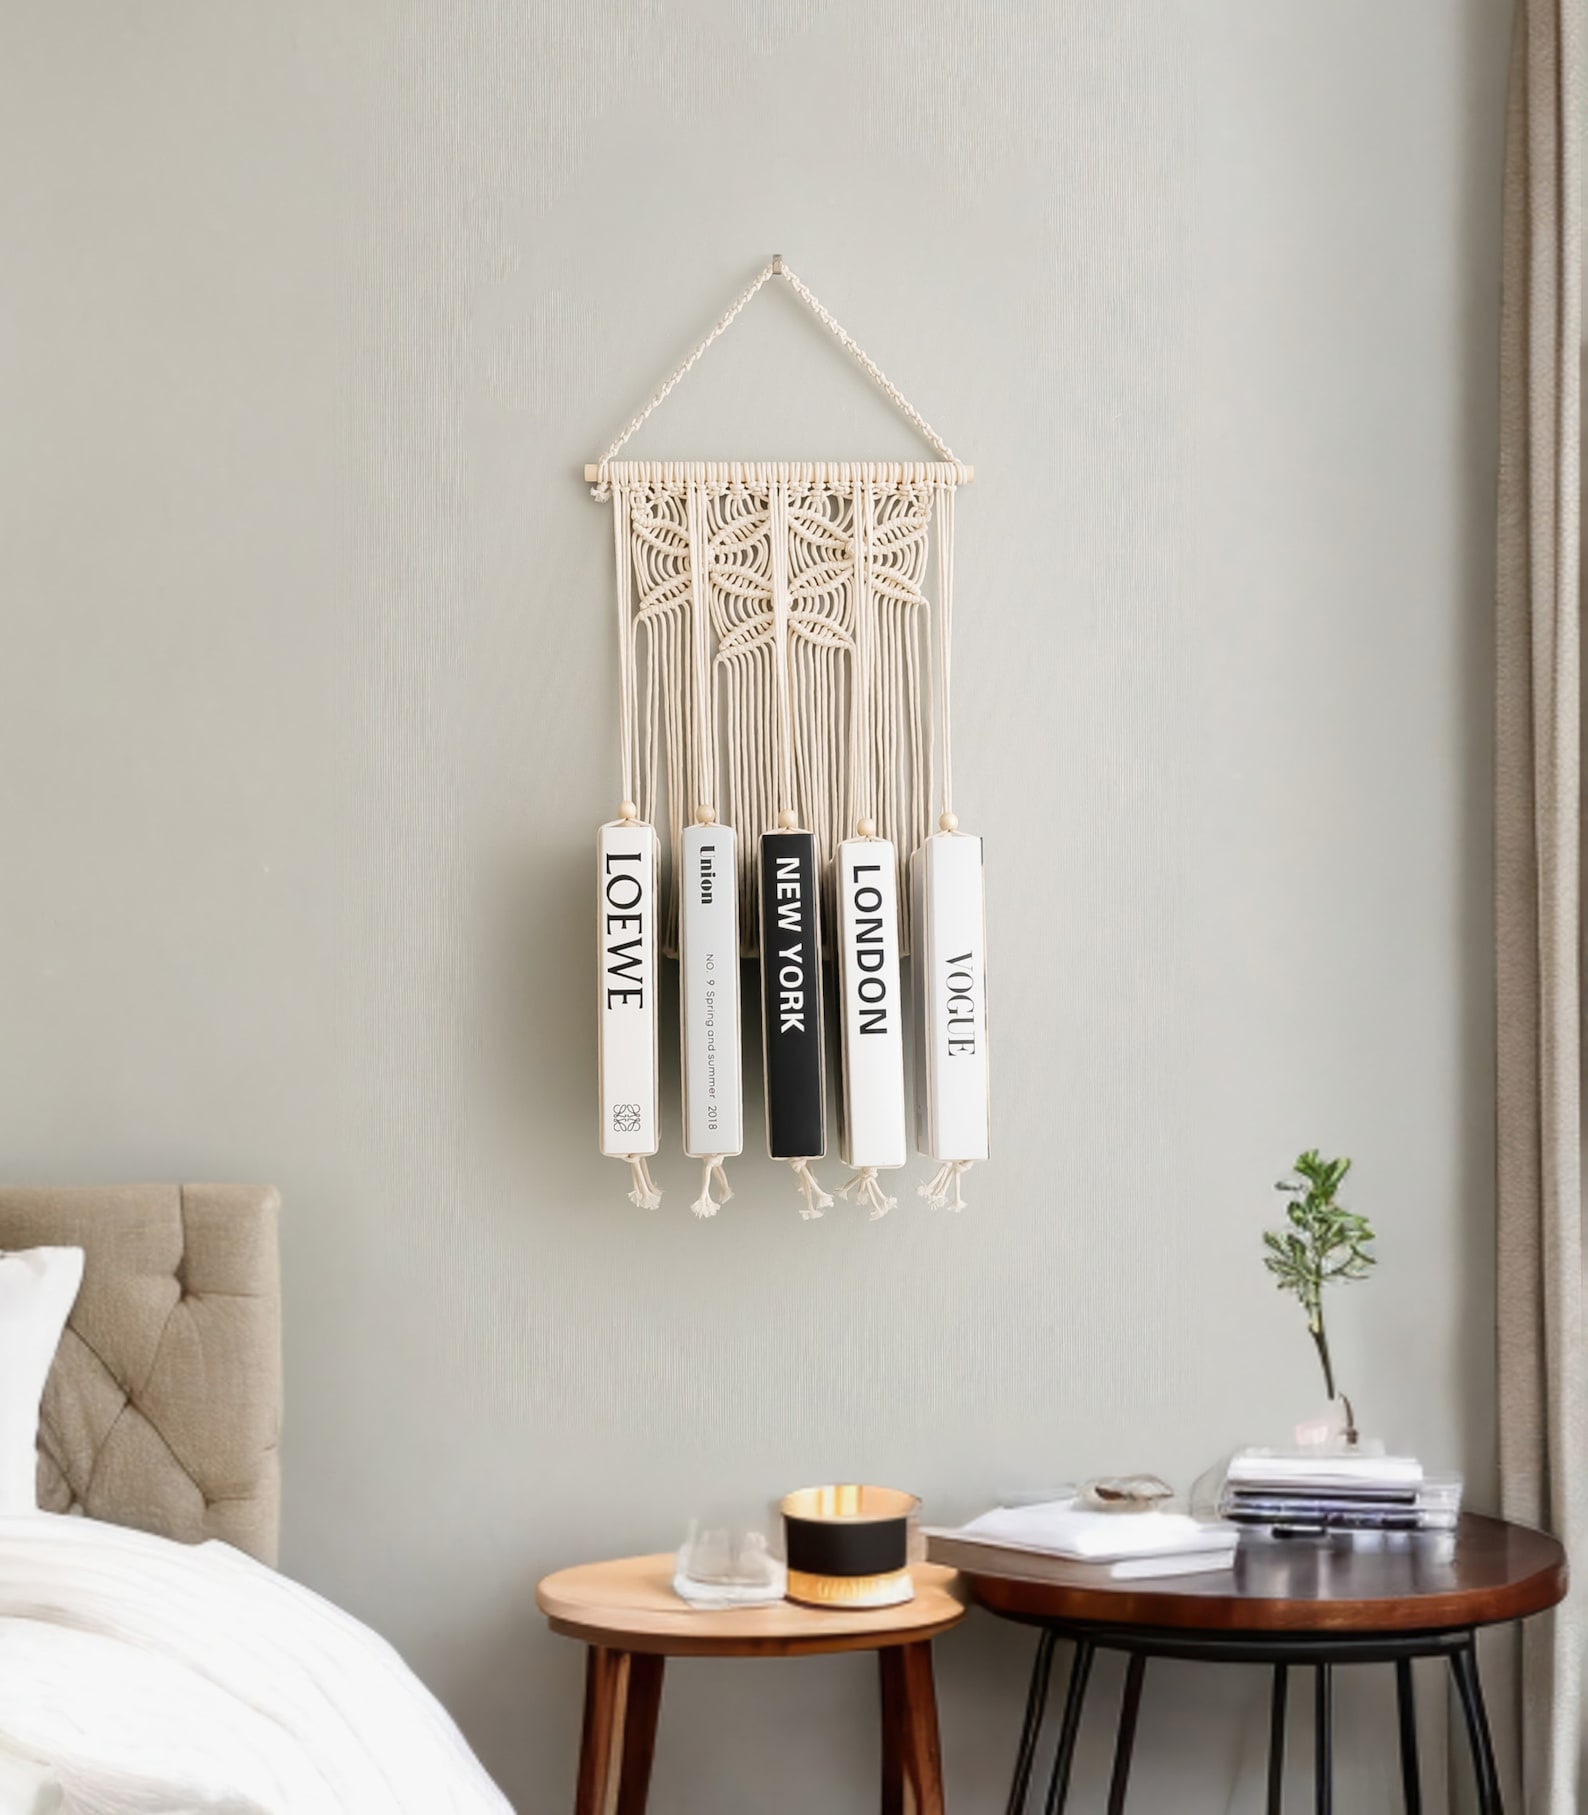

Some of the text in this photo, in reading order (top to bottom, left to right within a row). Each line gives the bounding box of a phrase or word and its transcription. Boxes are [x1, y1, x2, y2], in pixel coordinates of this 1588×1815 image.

[700, 845, 716, 904] Union
[606, 853, 643, 1010] LOEWE
[776, 857, 805, 1034] NEW YORK
[853, 865, 888, 1035] LONDON
[707, 978, 716, 986] 9
[945, 951, 976, 1056] VOGUE
[705, 990, 716, 1028] Spring
[707, 1029, 716, 1052] and
[707, 1053, 716, 1099] summer
[707, 1105, 718, 1130] 2018
